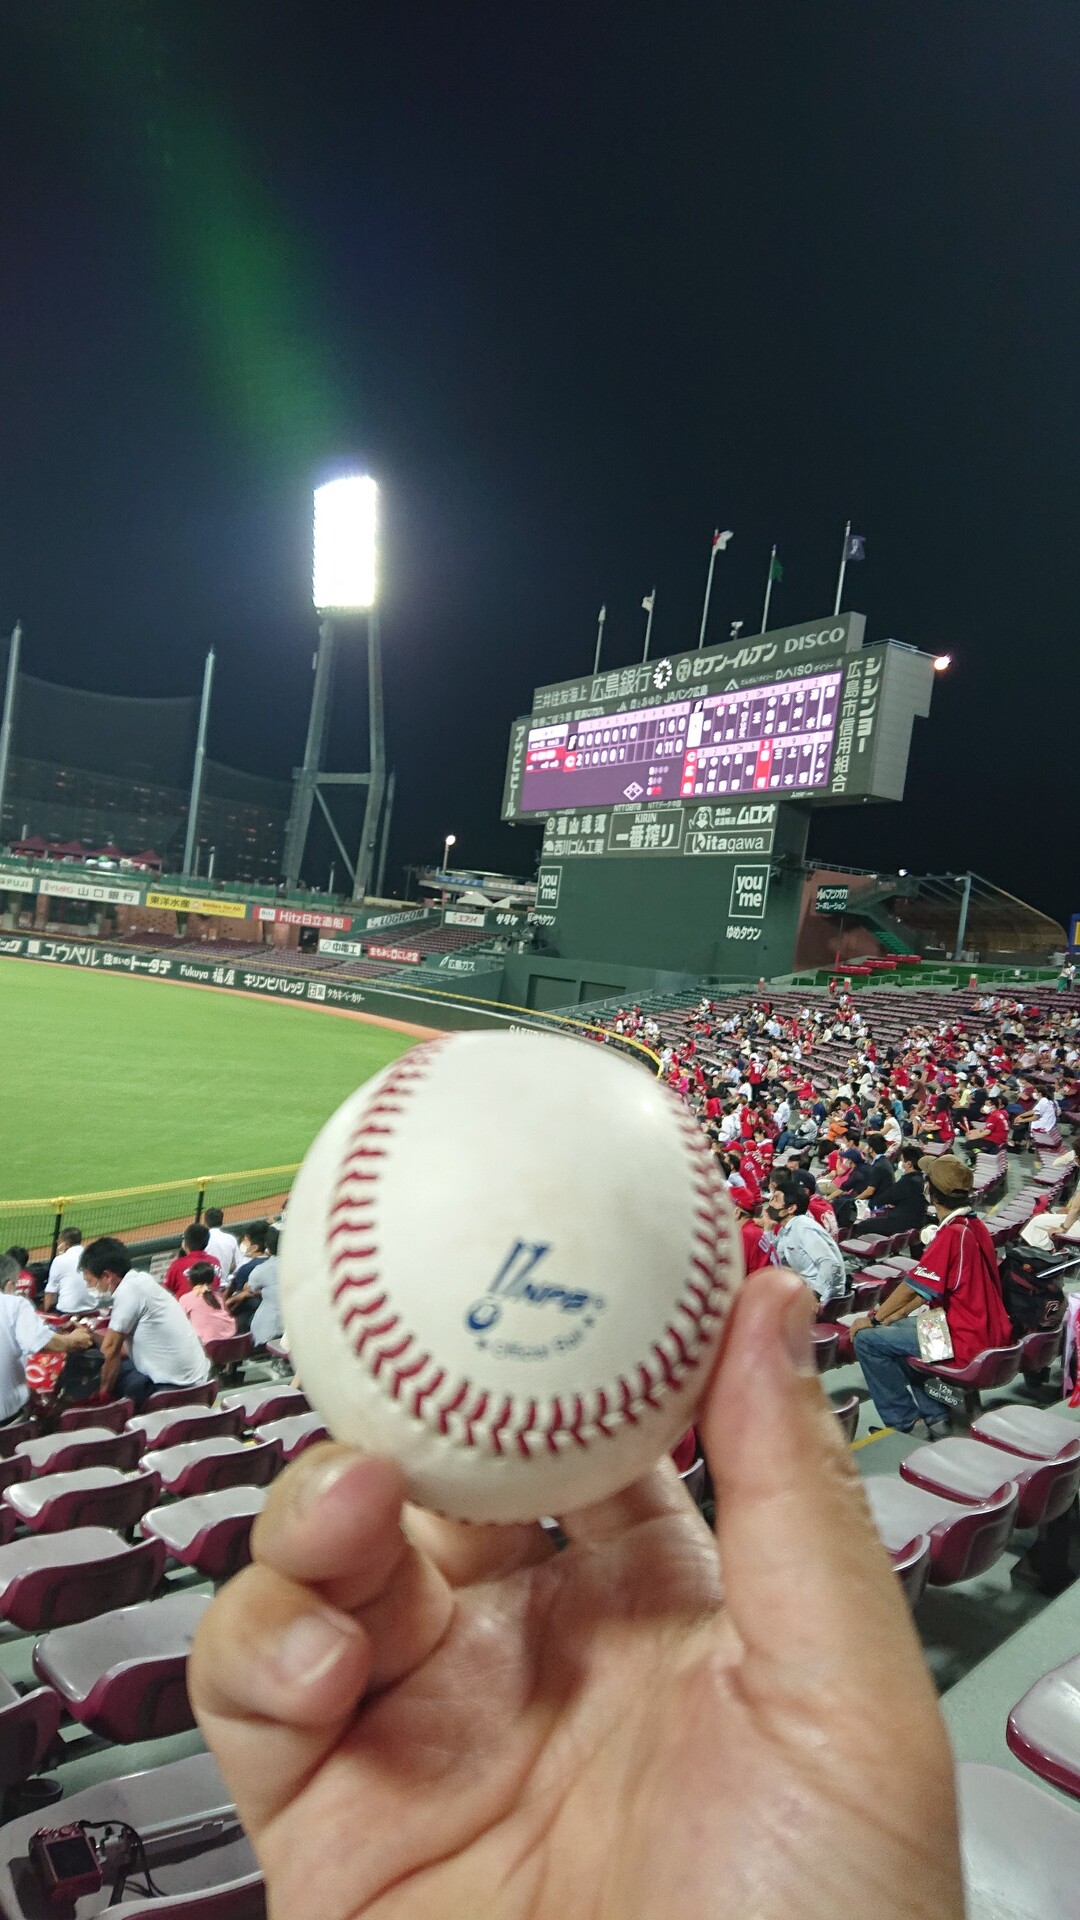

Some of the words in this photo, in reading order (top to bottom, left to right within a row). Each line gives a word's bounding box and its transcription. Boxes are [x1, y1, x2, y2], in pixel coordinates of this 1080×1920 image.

[784, 627, 845, 653] DISCO
[776, 663, 812, 680] DAISO
[590, 666, 651, 702] 広島銀行
[534, 688, 587, 710] 三井住友海上
[857, 657, 882, 752] シシンヨー
[622, 728, 627, 740] 1
[660, 722, 664, 734] 1
[668, 719, 675, 733] 6
[832, 660, 863, 793] 広島市信用組合
[585, 753, 590, 764] 1
[620, 748, 624, 760] 1
[656, 743, 662, 755] 4
[665, 741, 673, 754] 11
[506, 726, 525, 817] アサヒビール
[635, 813, 657, 823] KIRIN
[737, 804, 776, 824] ムロオ
[616, 824, 674, 848] 一番搾り
[554, 838, 604, 856] 西川ゴム工業
[540, 874, 557, 889] you
[736, 875, 763, 894] you
[78, 887, 134, 903] 山口銀行
[151, 896, 190, 908] 東洋水産
[542, 888, 557, 900] me
[739, 892, 762, 907] me
[816, 902, 846, 910] コーポレーション
[279, 912, 344, 928] Hitz日立造船
[380, 909, 425, 925] LOGICOM
[496, 914, 519, 926] サタケ
[726, 925, 761, 940] ゆめタウン
[40, 942, 100, 966] ユウベル
[333, 942, 357, 954] 中電工
[448, 959, 475, 971] 広島ガス
[180, 964, 209, 980] Fukuya
[212, 967, 235, 986] 福屋
[244, 973, 304, 995] キリンビバレッジ
[327, 988, 366, 1004] タカキベーカリー
